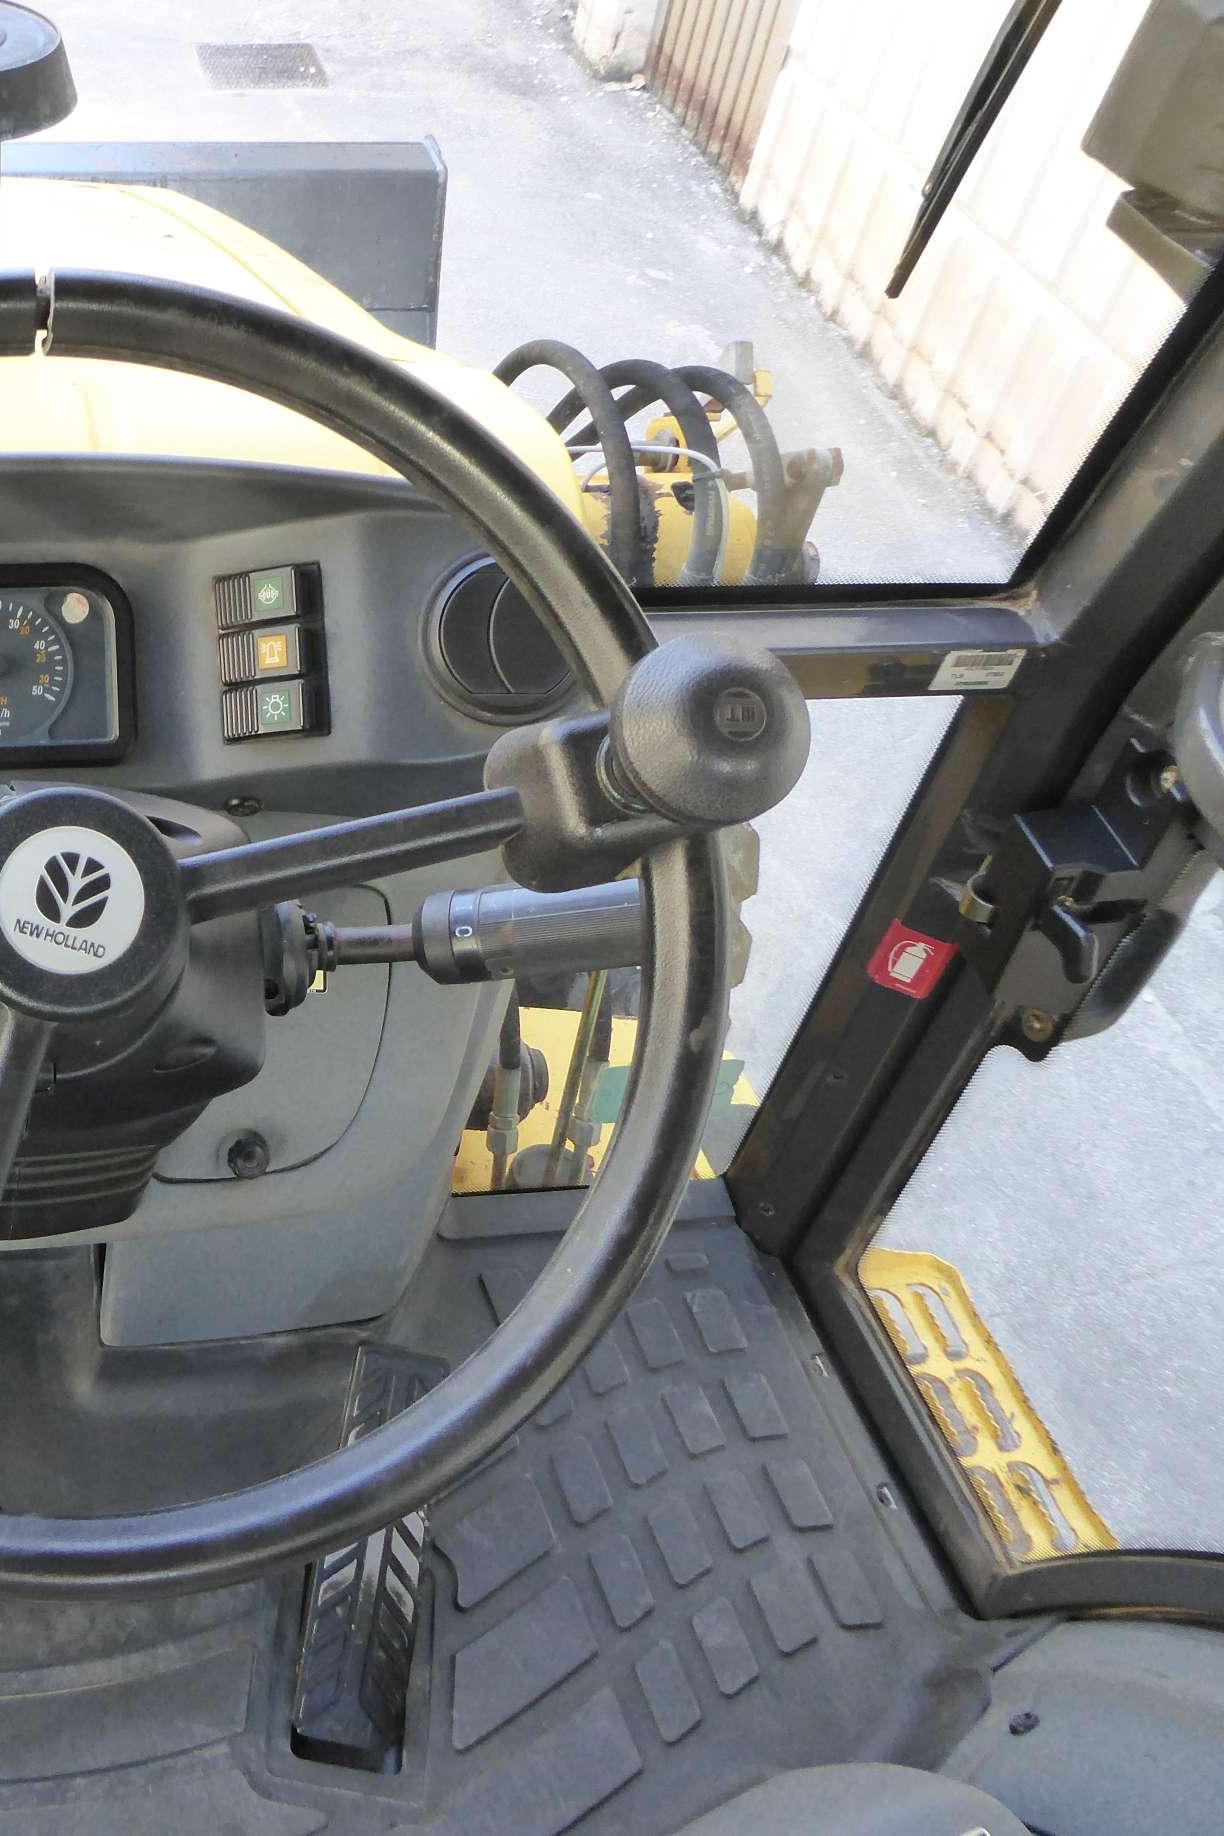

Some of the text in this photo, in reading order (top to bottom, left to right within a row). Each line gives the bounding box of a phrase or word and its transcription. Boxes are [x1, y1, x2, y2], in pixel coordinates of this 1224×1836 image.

[8, 619, 20, 629] 30
[19, 626, 30, 635] 20
[34, 640, 45, 650] 40
[32, 685, 43, 695] 50
[14, 918, 106, 958] NEW HOLLAND
